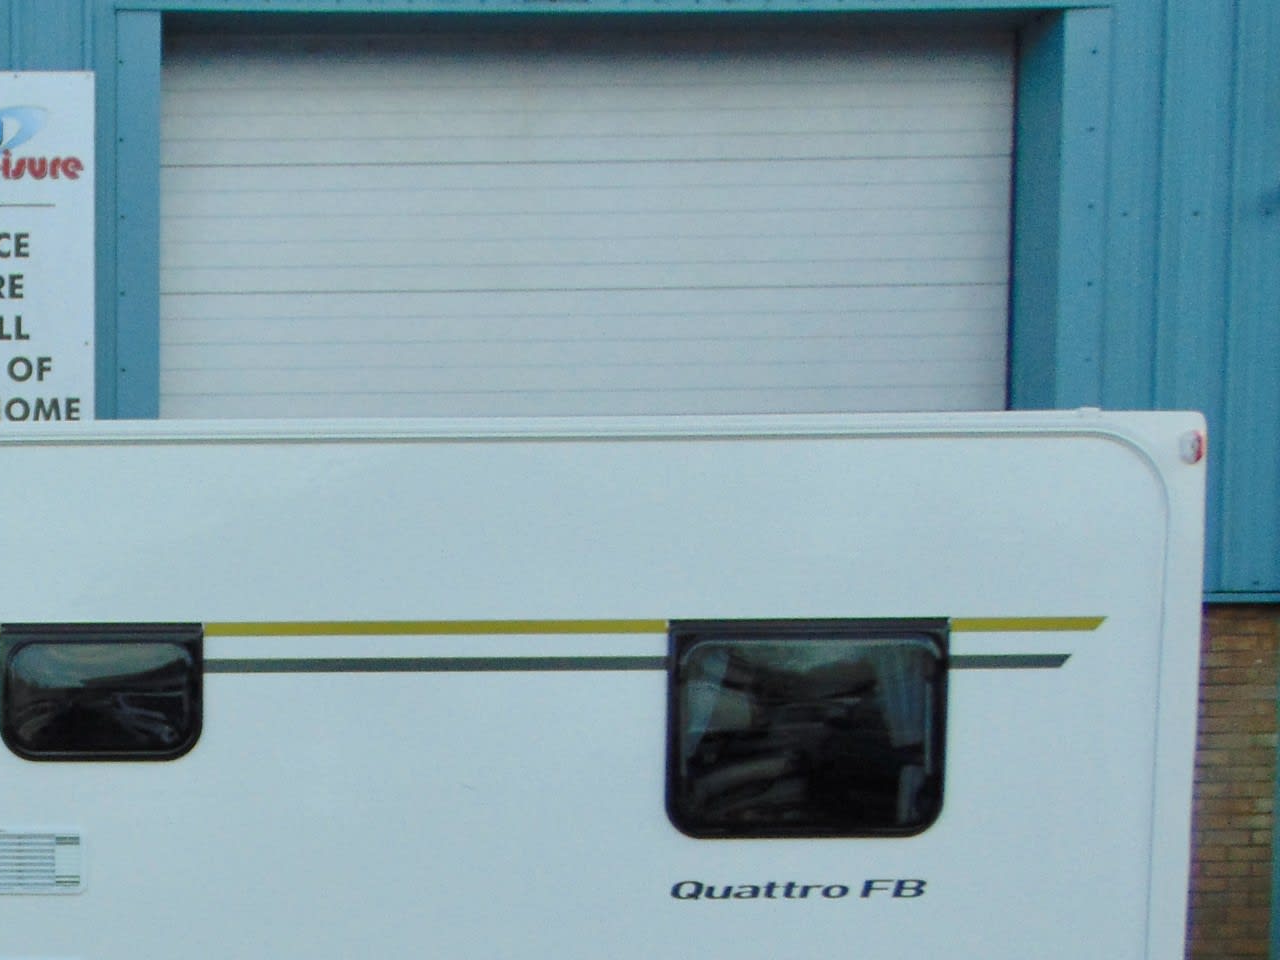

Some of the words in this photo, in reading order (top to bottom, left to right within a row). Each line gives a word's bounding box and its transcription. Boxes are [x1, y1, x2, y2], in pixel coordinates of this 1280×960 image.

[7, 356, 52, 383] OF
[670, 880, 849, 901] Quattro
[860, 879, 927, 899] FB
